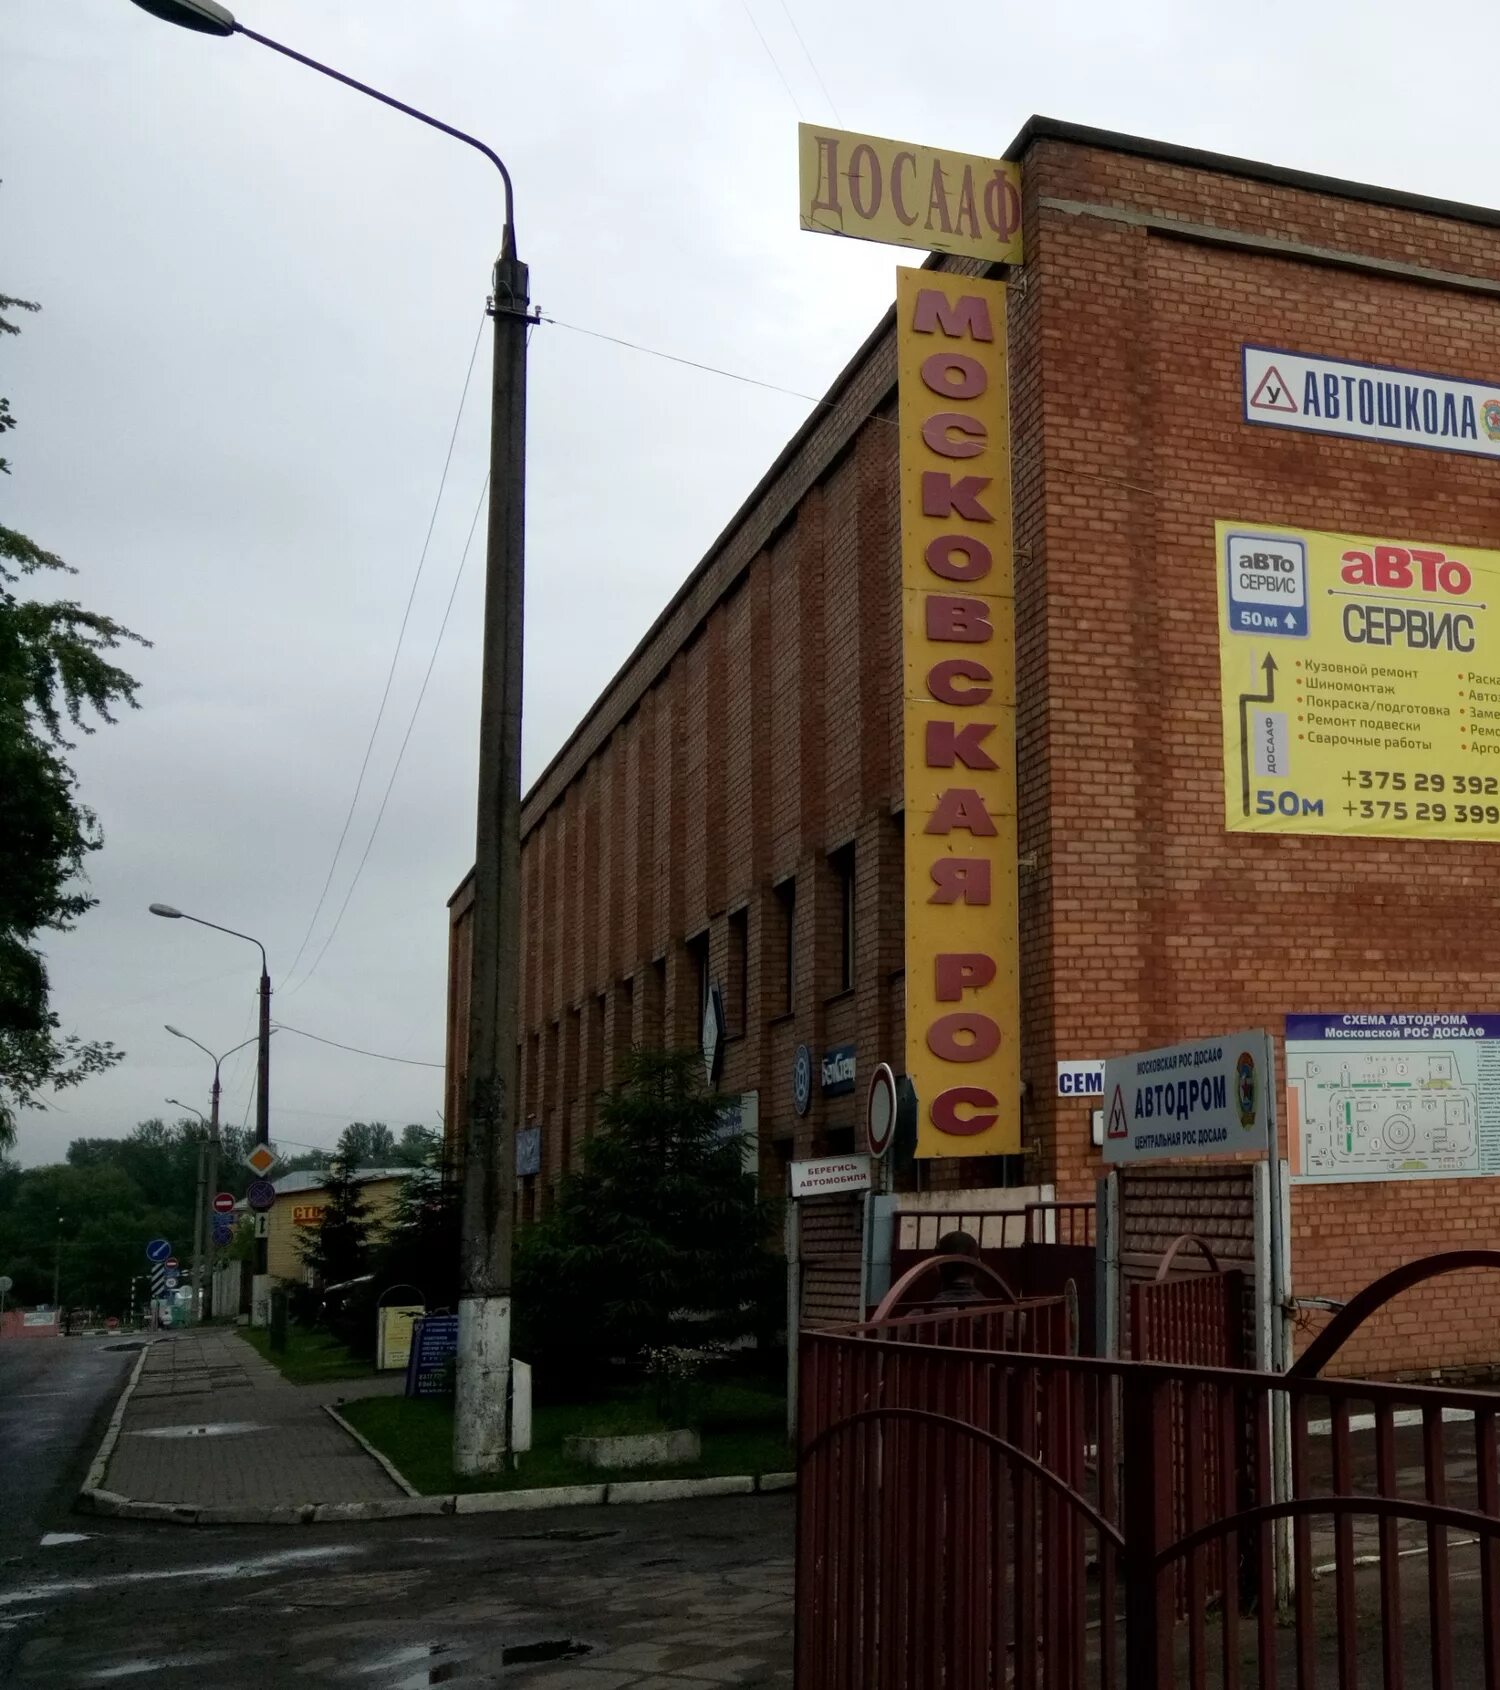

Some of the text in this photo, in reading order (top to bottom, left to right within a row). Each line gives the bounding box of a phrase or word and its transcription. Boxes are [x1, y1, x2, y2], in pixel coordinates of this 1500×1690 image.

[810, 135, 1021, 244] ДОСААФ
[1303, 370, 1478, 440] АВТОШКОЛА
[1240, 573, 1296, 594] СЕРВИС
[1343, 603, 1475, 653] СЕРВИС
[1304, 659, 1419, 679] Кузовной ремонт
[1305, 677, 1396, 695] Шиномонтаж
[912, 288, 1001, 1136] МОСКОВСКАЯ РОС
[1306, 695, 1451, 716] Покраска/подготовка
[1307, 713, 1421, 732] Ремонт подвески
[1265, 716, 1277, 774] ДОСААФ
[1307, 731, 1432, 750] Сварочные работы
[1341, 770, 1407, 791] +375
[1414, 773, 1445, 793] 29
[1342, 800, 1408, 821] +375
[1415, 802, 1447, 822] 29
[1342, 1014, 1469, 1027] СХЕМА АВТОДРОМА
[1324, 1027, 1485, 1039] Московской РОС ДОСААФ
[1136, 1047, 1223, 1076] МОСКОВСКАЯ РОС ДОСААФ
[1059, 1072, 1105, 1094] СЕМ
[1134, 1075, 1227, 1121] АВТОДРОМ
[1135, 1127, 1228, 1150] ЦЕНТРАЛЬНАЯ РОС ДОСААФ
[800, 1173, 867, 1188] АВТОМОБИЛЯ
[807, 1163, 857, 1176] БЕРЕГИСЬ
